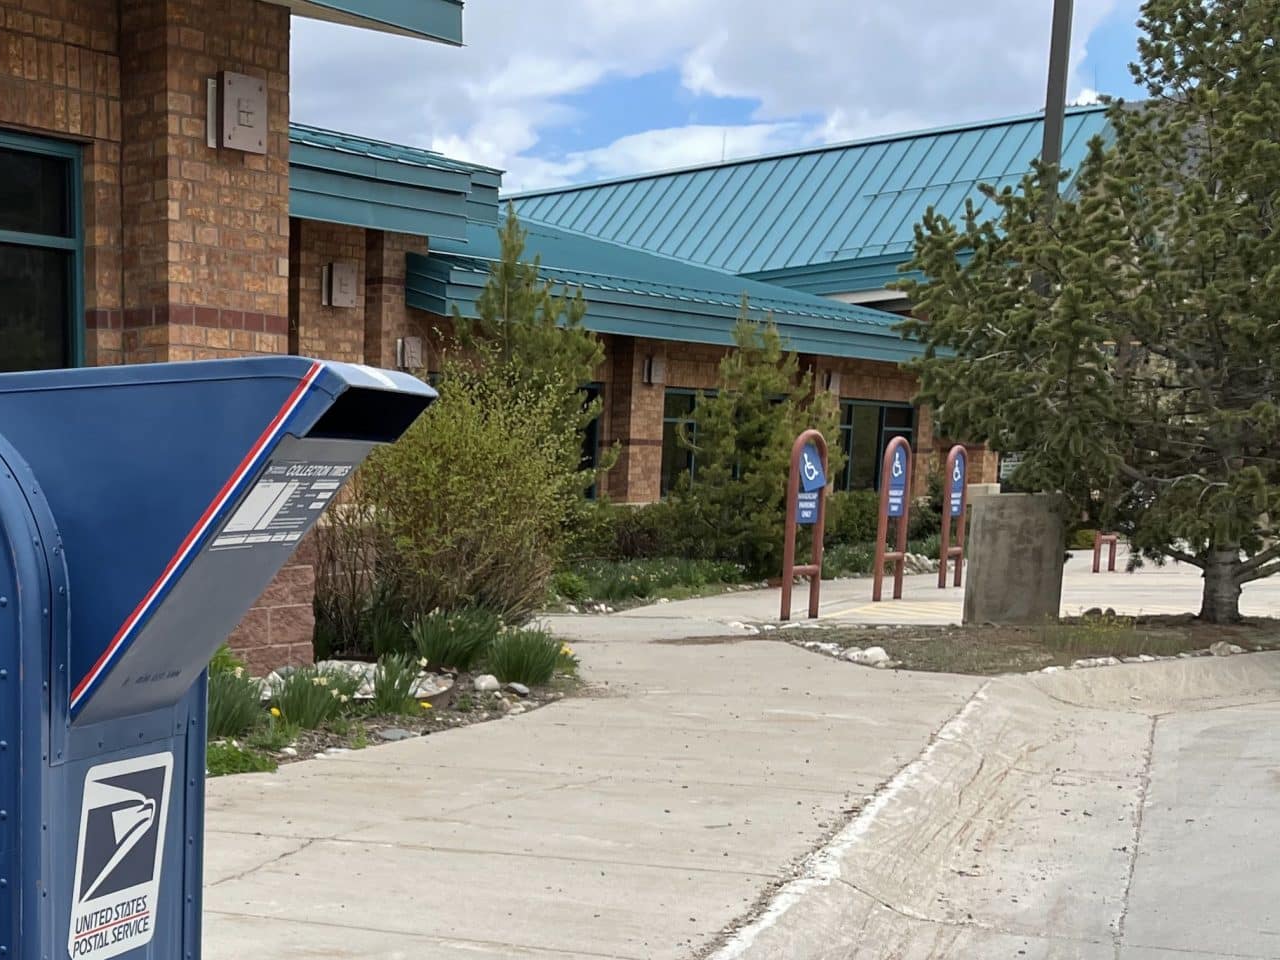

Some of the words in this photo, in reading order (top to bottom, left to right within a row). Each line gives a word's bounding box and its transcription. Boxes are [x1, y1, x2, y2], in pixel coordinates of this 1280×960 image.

[75, 907, 113, 934] UNITED
[114, 895, 148, 920] STATES
[73, 930, 110, 959] POSTAL
[111, 916, 150, 944] SERVICE
